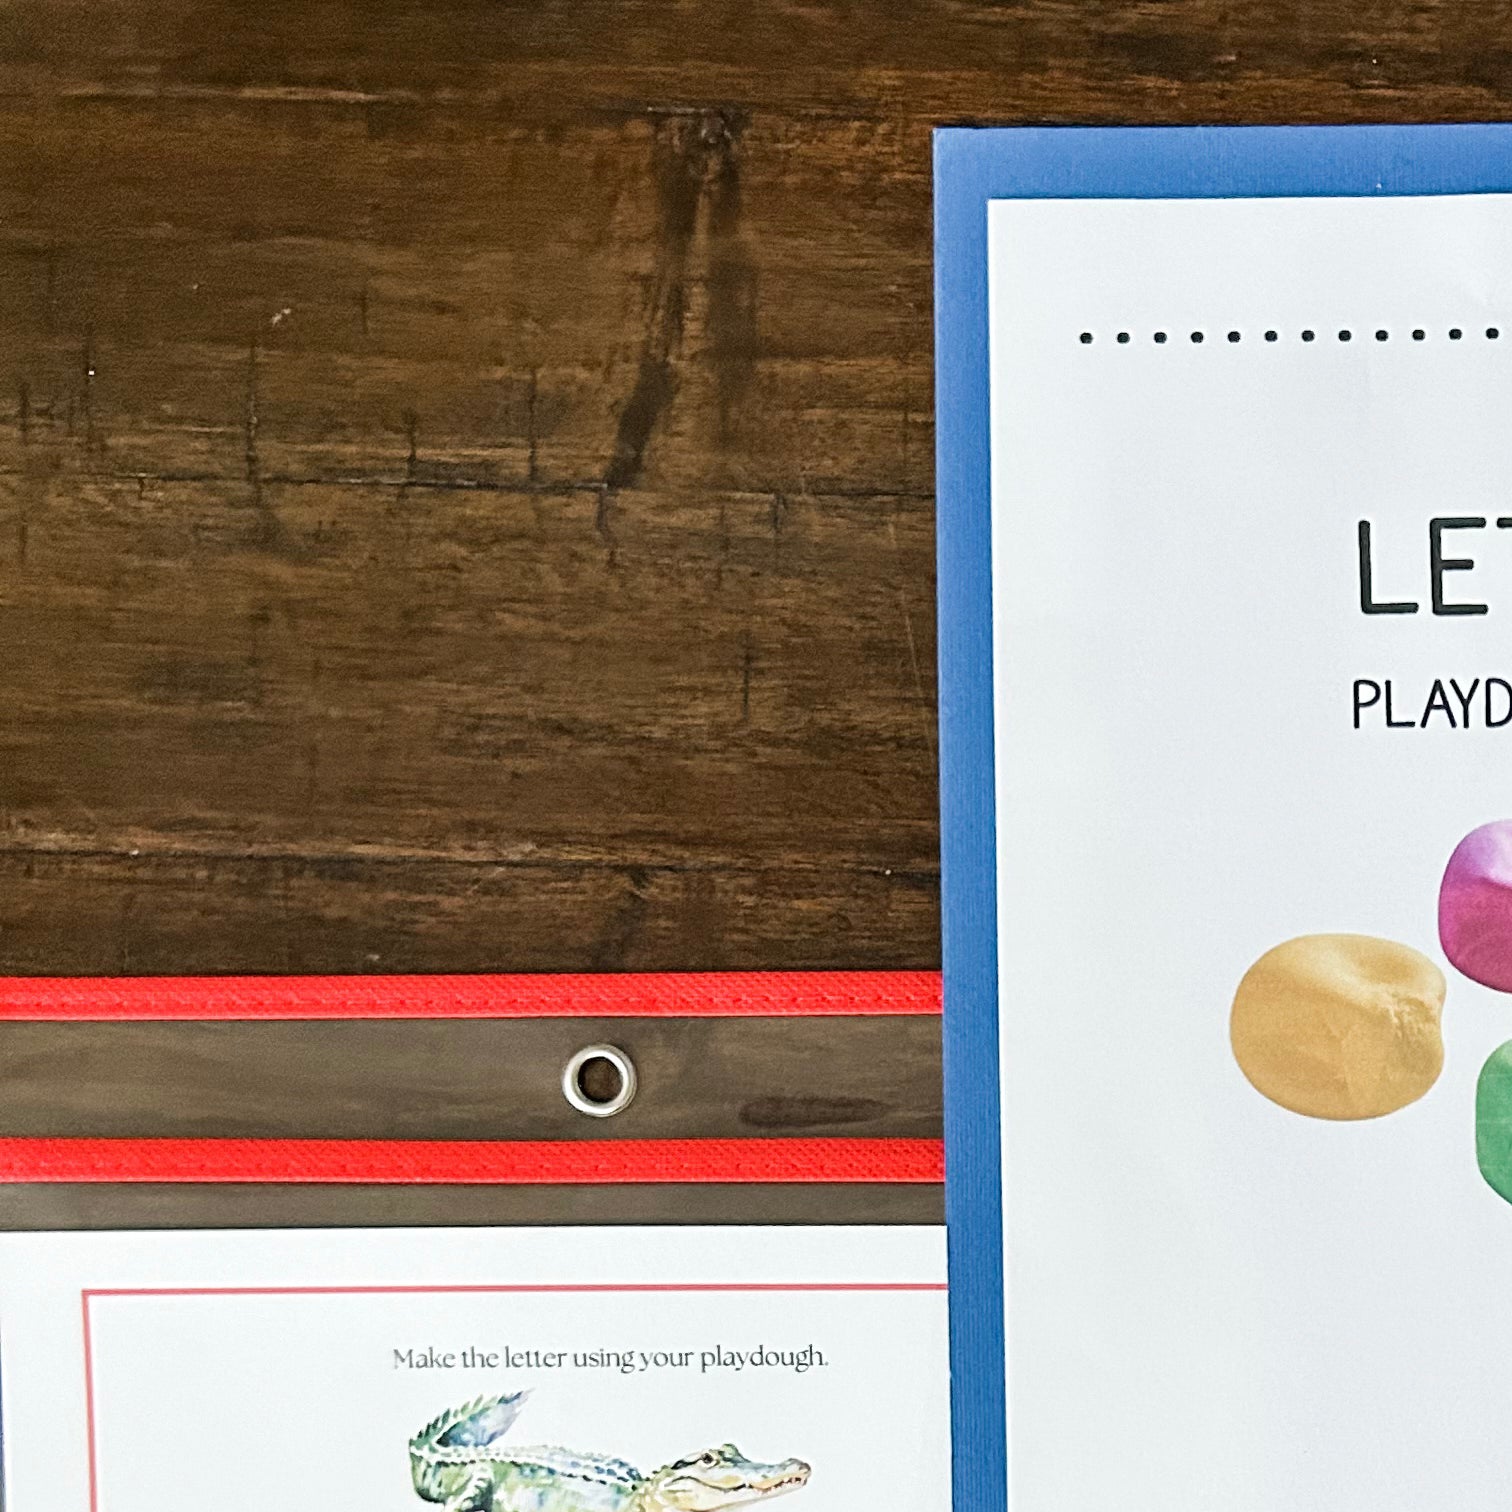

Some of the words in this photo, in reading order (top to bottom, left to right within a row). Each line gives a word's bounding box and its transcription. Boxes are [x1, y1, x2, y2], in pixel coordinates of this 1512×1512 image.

[393, 1346, 455, 1369] Make
[461, 1345, 499, 1368] the
[505, 1345, 567, 1368] letter
[573, 1347, 635, 1373] using
[638, 1349, 695, 1369] your
[701, 1344, 829, 1373] playdough.
